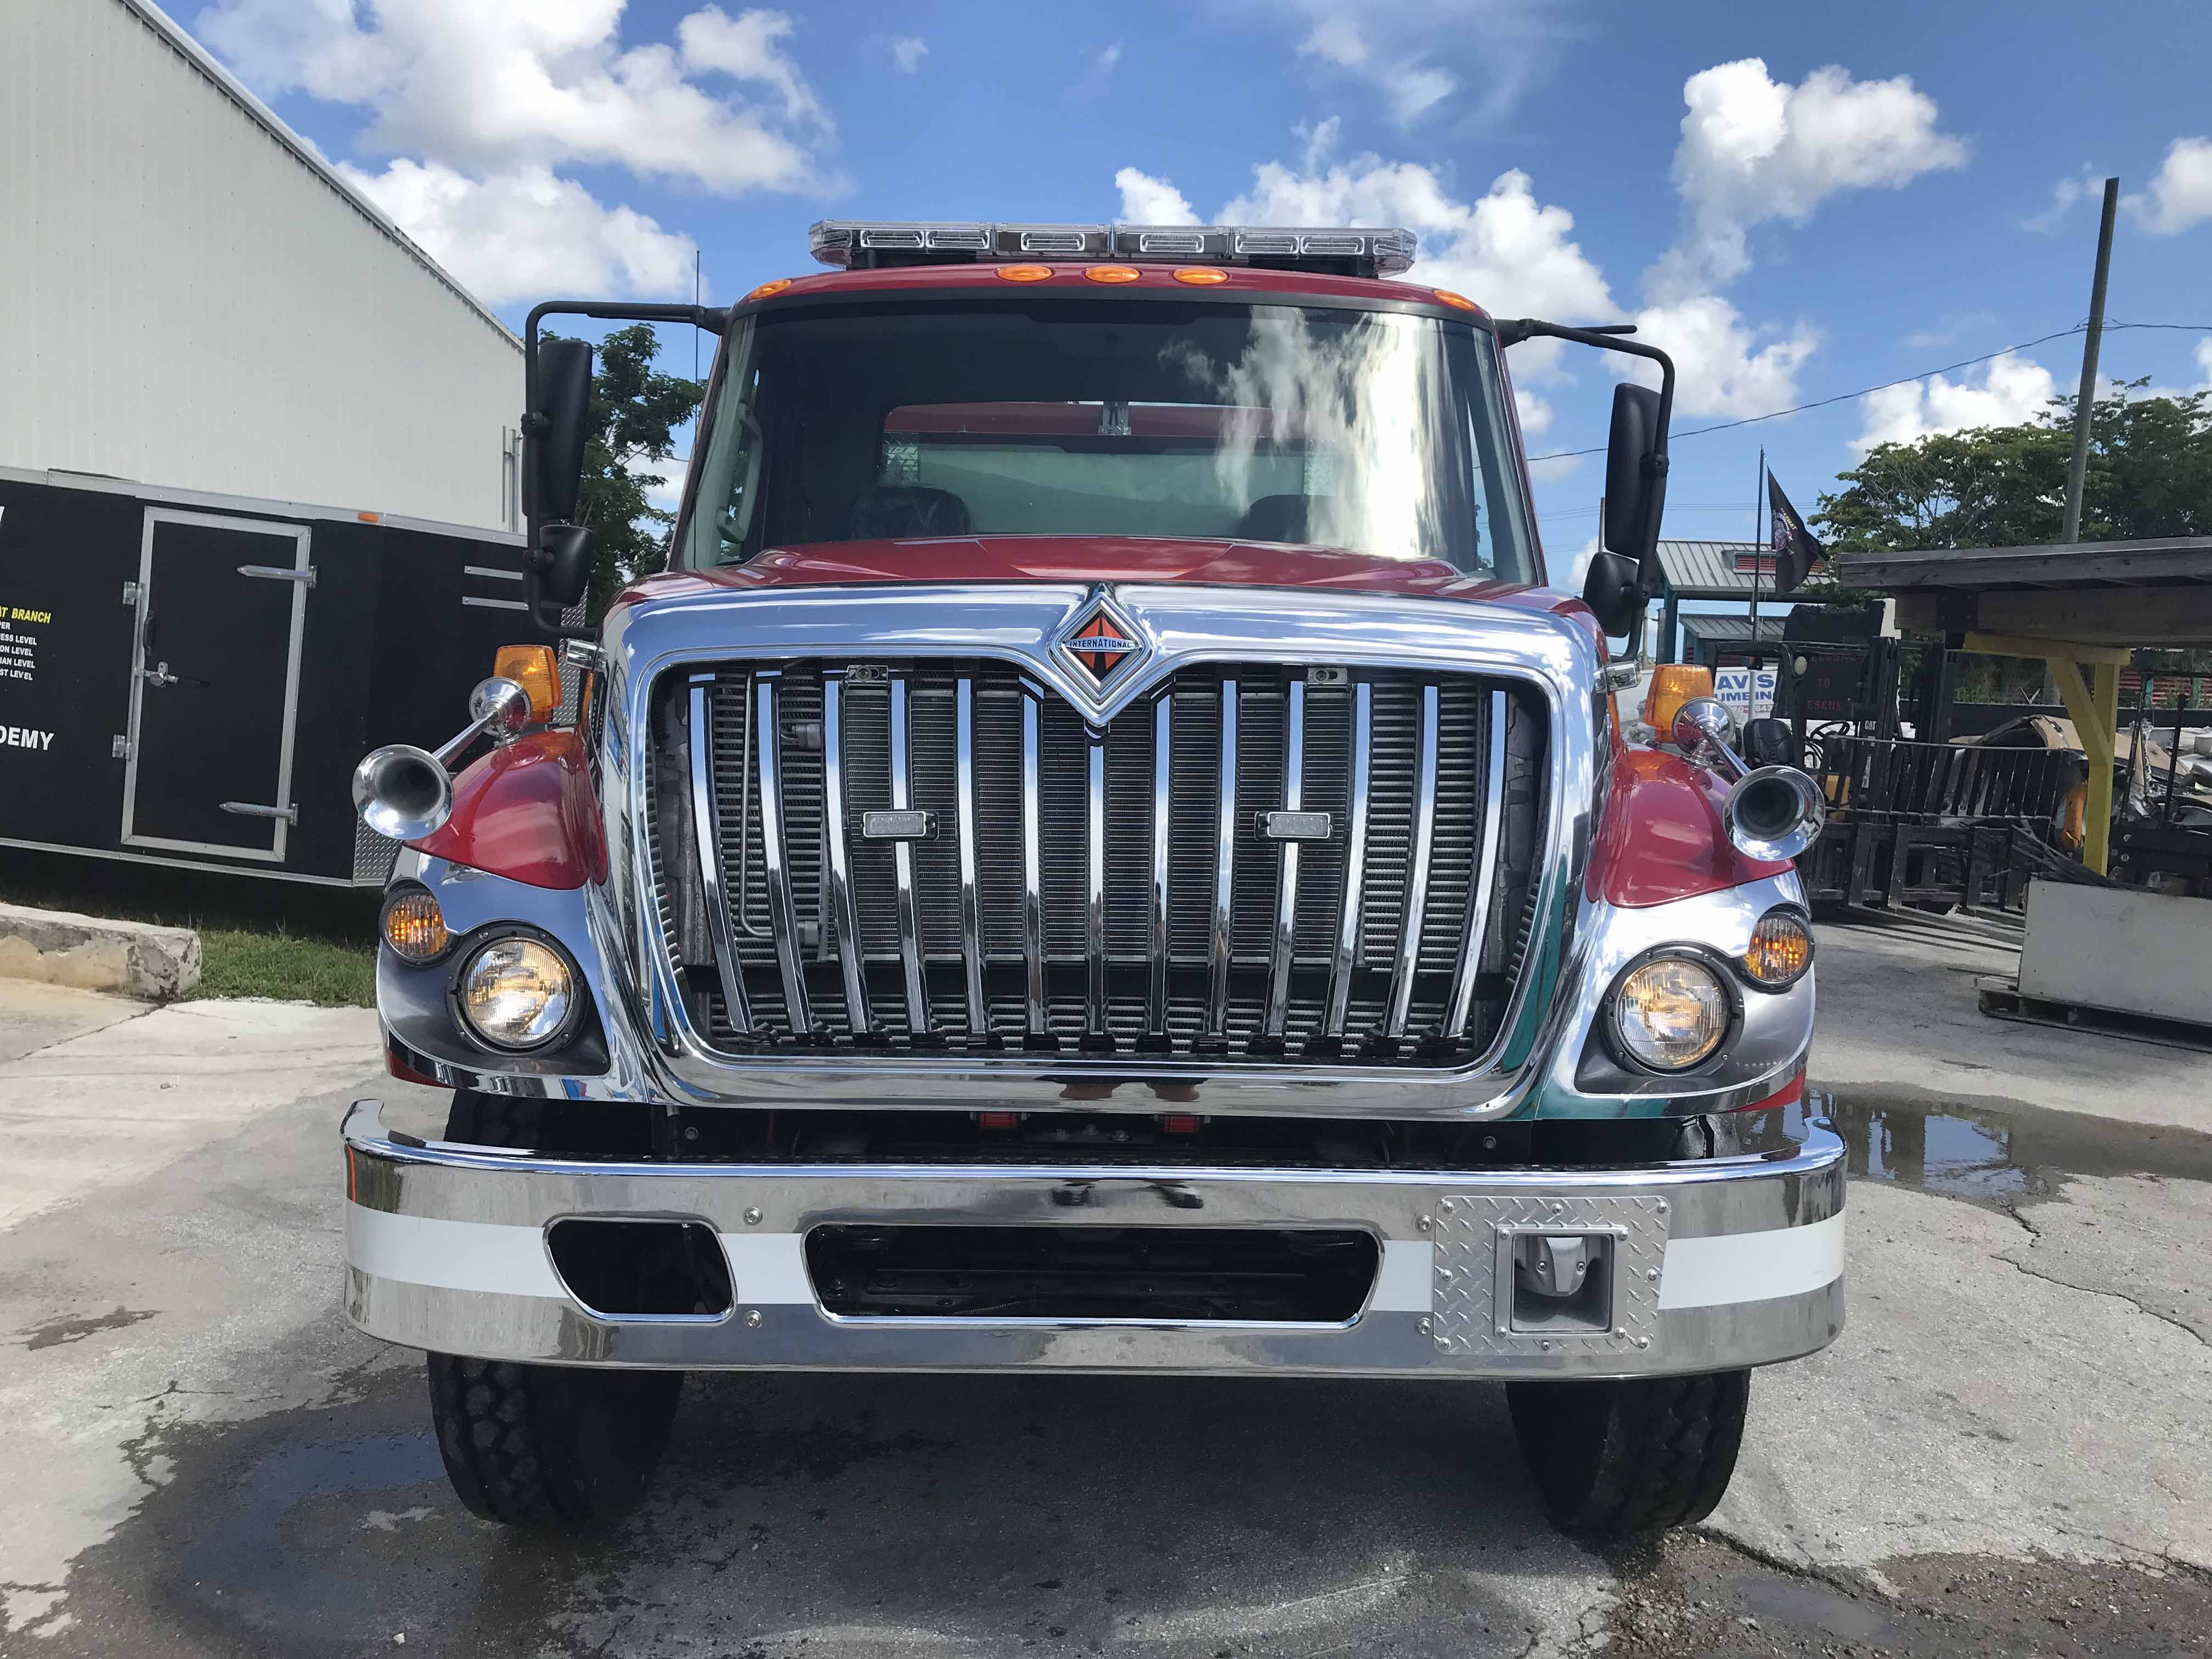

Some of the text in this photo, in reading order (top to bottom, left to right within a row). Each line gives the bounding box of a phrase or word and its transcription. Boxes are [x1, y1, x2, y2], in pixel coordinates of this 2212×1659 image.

[12, 608, 52, 624] BRANCH
[15, 635, 37, 646] LEVEL
[1069, 638, 1131, 648] INTERNATIONAL
[11, 646, 33, 657] LEVEL
[14, 658, 36, 669] LEVEL
[10, 669, 33, 680] LEVEL
[1865, 720, 1877, 730] CAT
